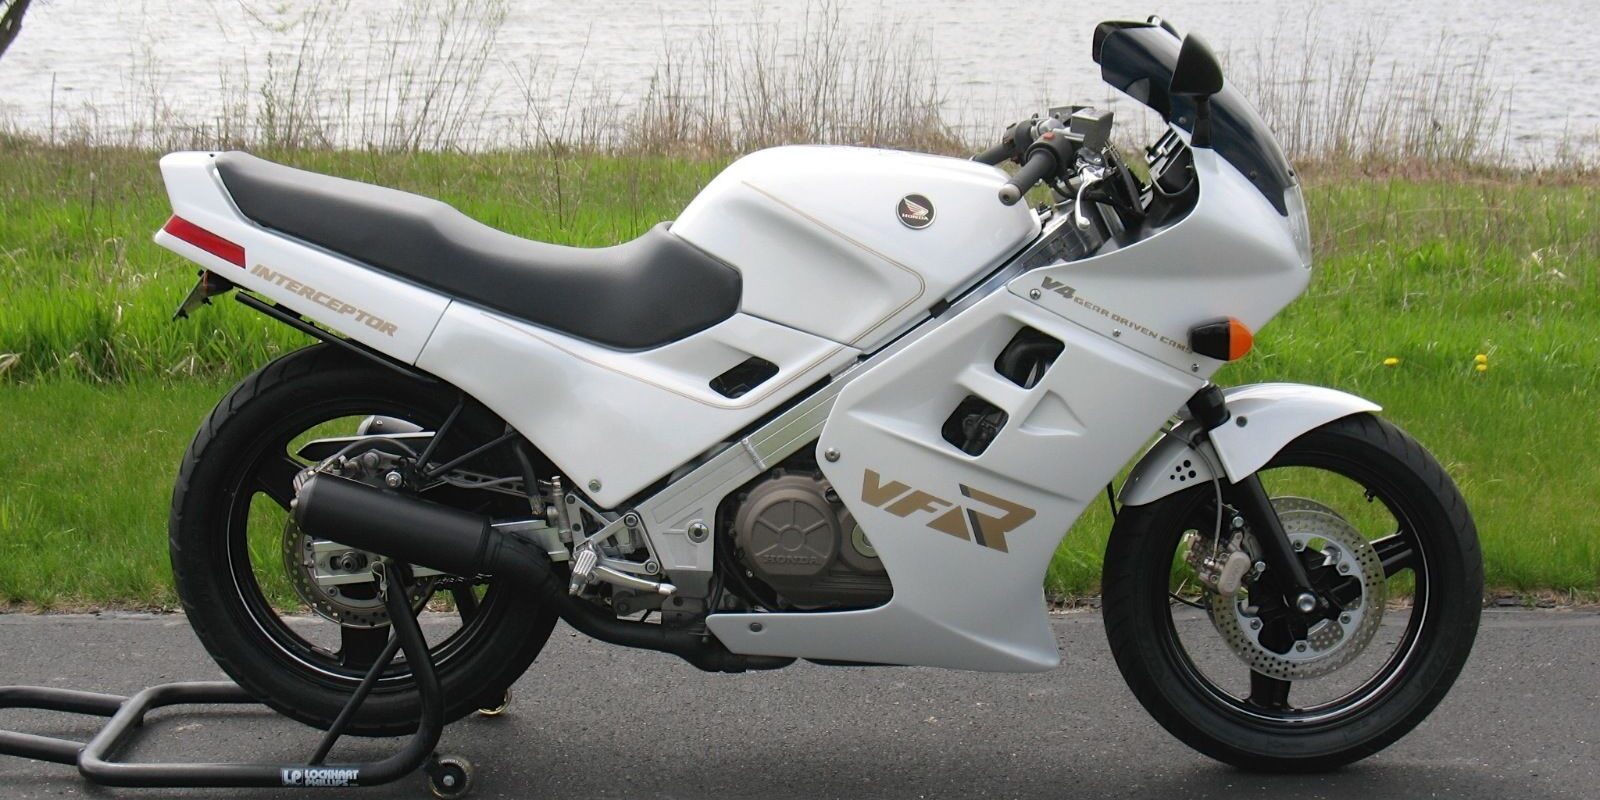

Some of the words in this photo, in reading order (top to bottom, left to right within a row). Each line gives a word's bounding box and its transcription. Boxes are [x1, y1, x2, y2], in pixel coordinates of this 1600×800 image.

[250, 263, 398, 337] INTERCEPTOR
[1041, 275, 1076, 299] V4
[1073, 296, 1110, 317] GEAR
[1111, 313, 1159, 339] DRIVEN
[861, 468, 1037, 554] VFR
[763, 554, 820, 566] HONDA
[283, 769, 302, 784] LP
[304, 769, 359, 780] LOCKHART
[304, 779, 349, 787] PHILLIPS
